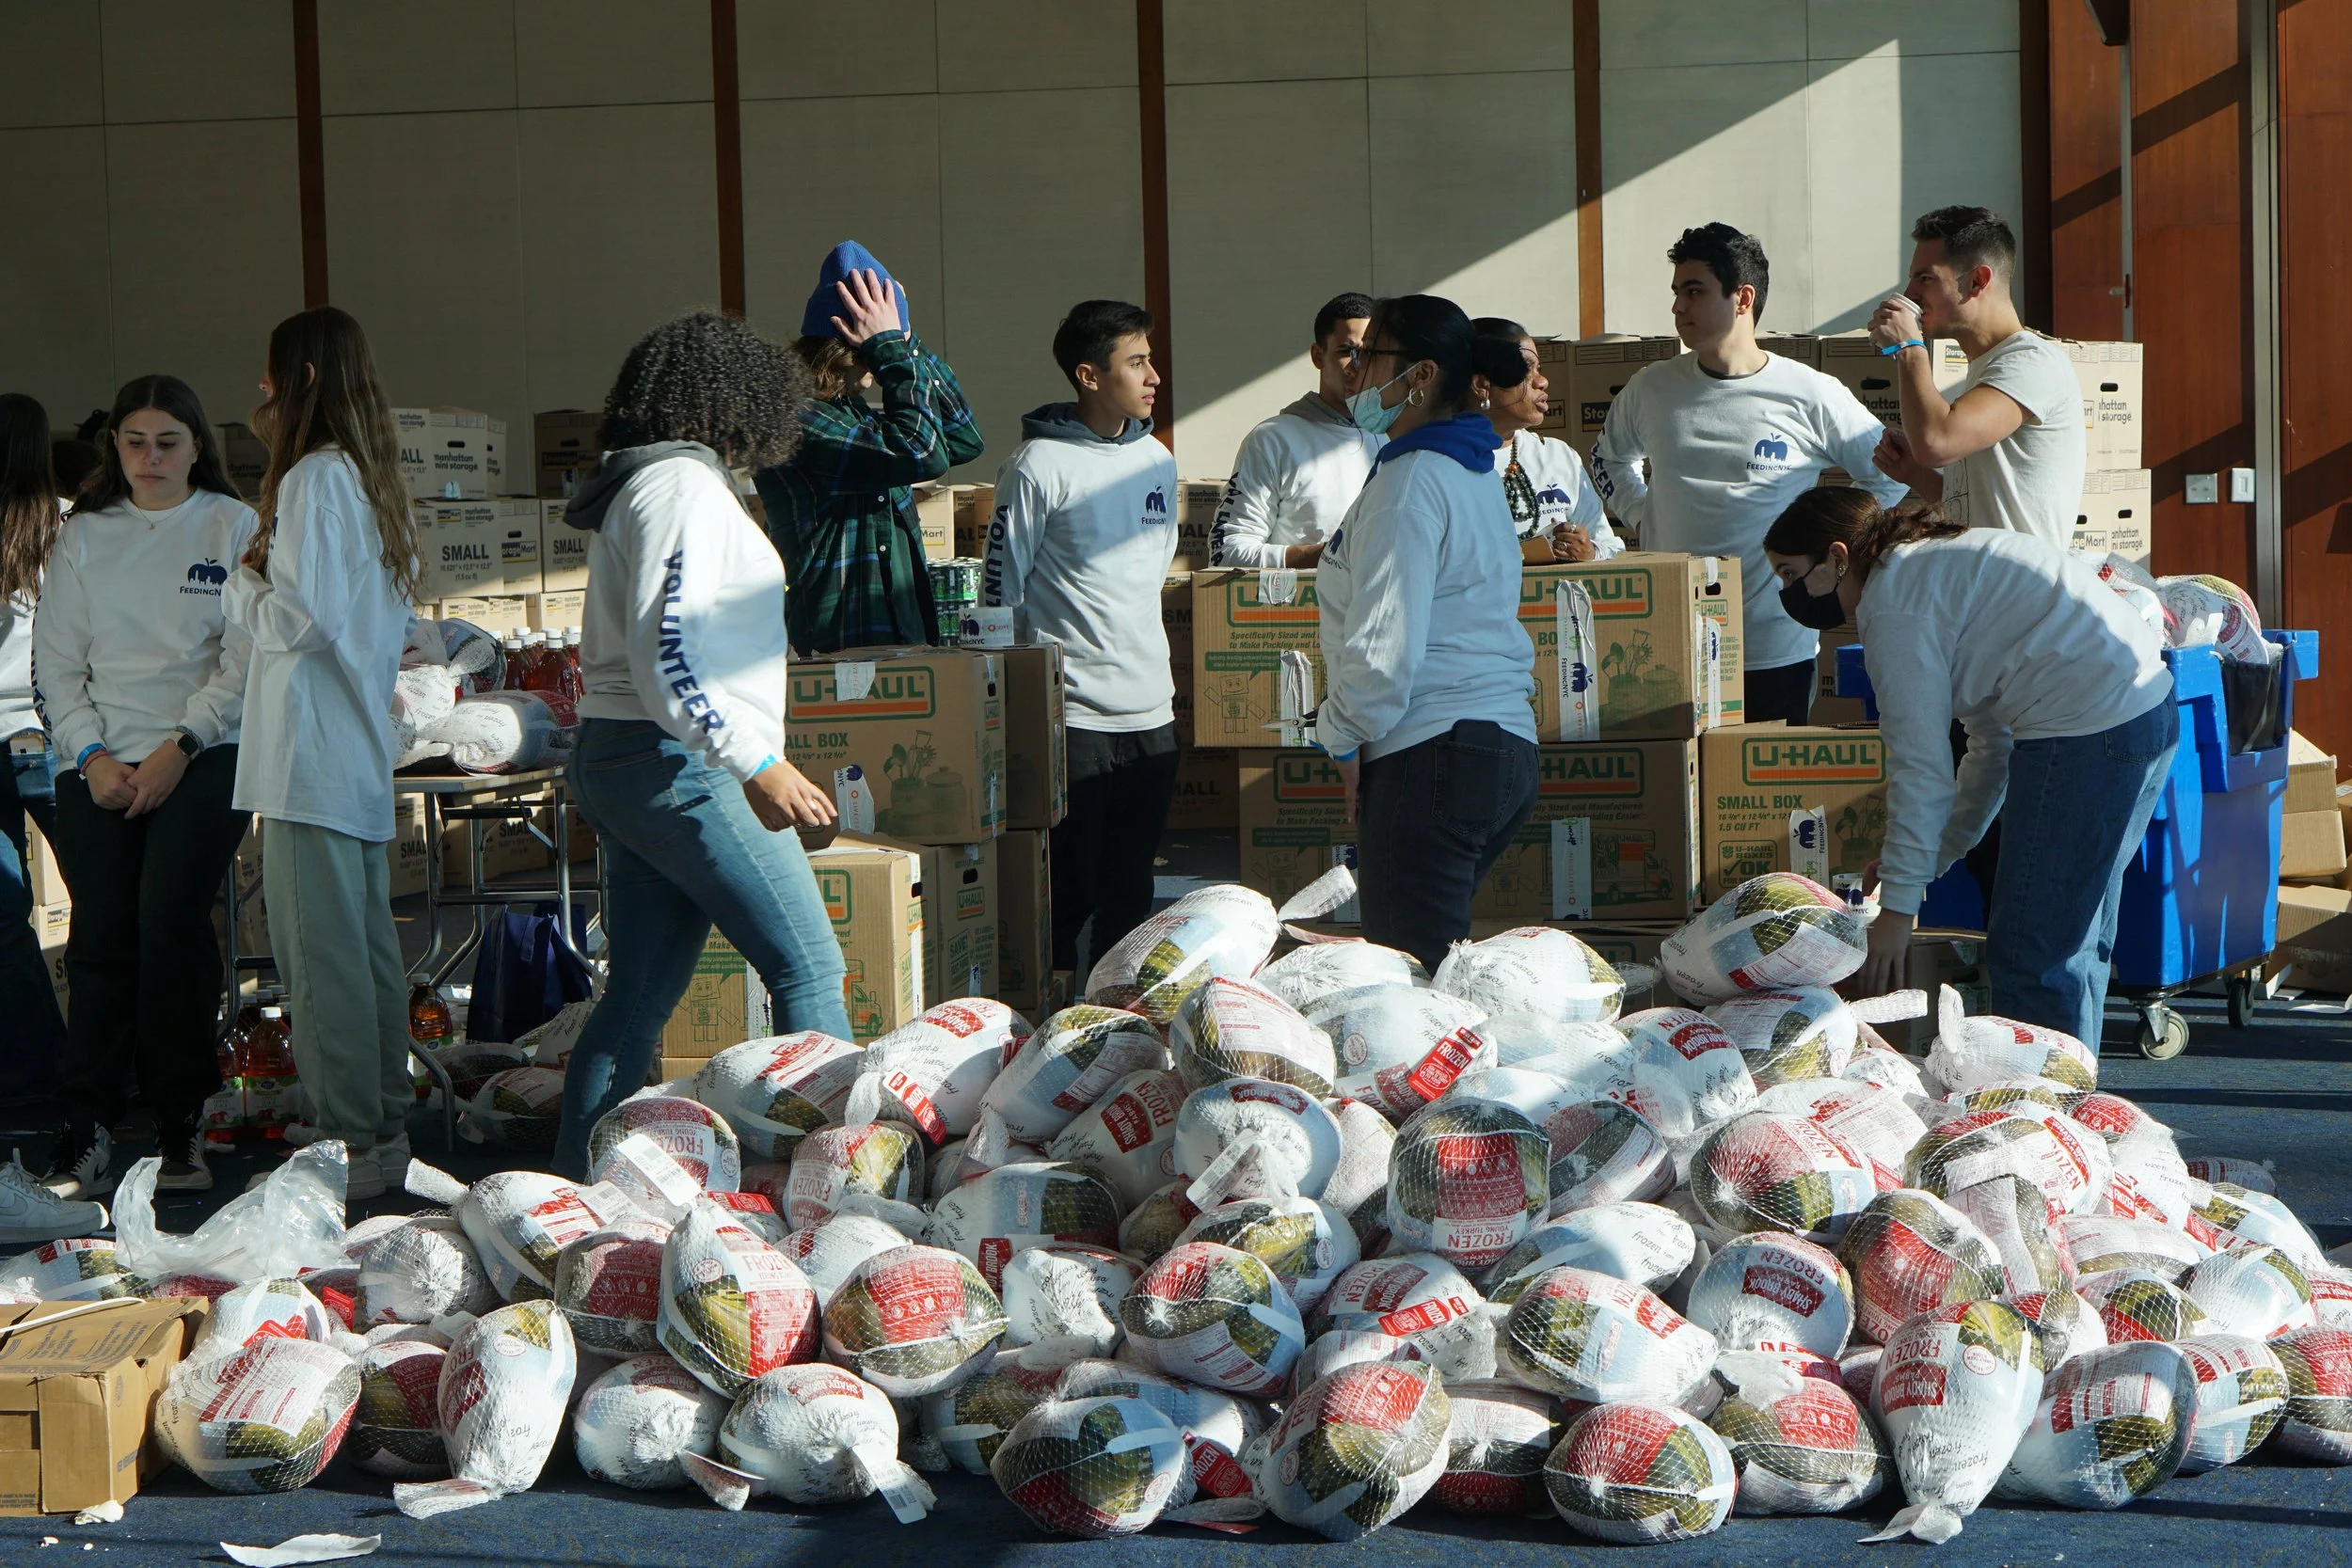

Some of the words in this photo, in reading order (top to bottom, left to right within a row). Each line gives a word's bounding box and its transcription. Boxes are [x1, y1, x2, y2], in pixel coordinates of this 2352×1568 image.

[2102, 411, 2133, 424] storage
[401, 449, 423, 464] ALL
[450, 461, 478, 472] storage
[2111, 527, 2139, 540] anhattan
[441, 544, 490, 562] SMALL
[553, 538, 584, 555] SMALL
[2119, 538, 2144, 551] storage
[180, 585, 222, 596] FEEDINGN
[659, 549, 724, 735] VOLUNTEER
[1231, 631, 1277, 641] Specifically
[1537, 631, 1557, 646] BO
[1239, 641, 1261, 649] Make
[1262, 641, 1294, 650] Packing
[1295, 641, 1311, 649] and
[785, 733, 812, 750] ALL
[818, 732, 850, 748] BOX
[1753, 744, 1877, 767] U-HAUL
[1540, 756, 1635, 780] -HAUL
[1174, 781, 1221, 798] ALL
[1588, 801, 1644, 811] Manufactured
[1717, 796, 1768, 810] SMALL
[1773, 795, 1803, 809] BOX
[1718, 823, 1732, 832] 1.5
[1734, 823, 1746, 832] CU
[1749, 822, 1760, 832] FT
[1740, 861, 1772, 875] OK
[959, 892, 983, 909] U-HAUL
[708, 941, 731, 949] Make
[1437, 1041, 1469, 1070] FROZEN
[1606, 1073, 1633, 1087] froz
[1134, 1080, 1175, 1128] FROZEN
[793, 1178, 833, 1203] FROZEN
[1454, 1226, 1484, 1234] TURKEY
[1486, 1224, 1509, 1233] YOUNG
[1447, 1229, 1514, 1249] FROZEN
[1631, 1230, 1661, 1254] frozen
[985, 1243, 998, 1272] BROOK
[1760, 1250, 1825, 1286] FROZEN
[1749, 1277, 1782, 1294] BROOK
[1781, 1287, 1813, 1310] SHADY
[1421, 1301, 1447, 1325] FROZEN
[1412, 1331, 1438, 1355] frozen
[1886, 1338, 1942, 1370] FROZEN
[830, 1379, 858, 1394] SHADY
[1905, 1380, 1939, 1399] SHADY
[1193, 1445, 1220, 1481] FROZEN
[1954, 1449, 1989, 1471] frozen
